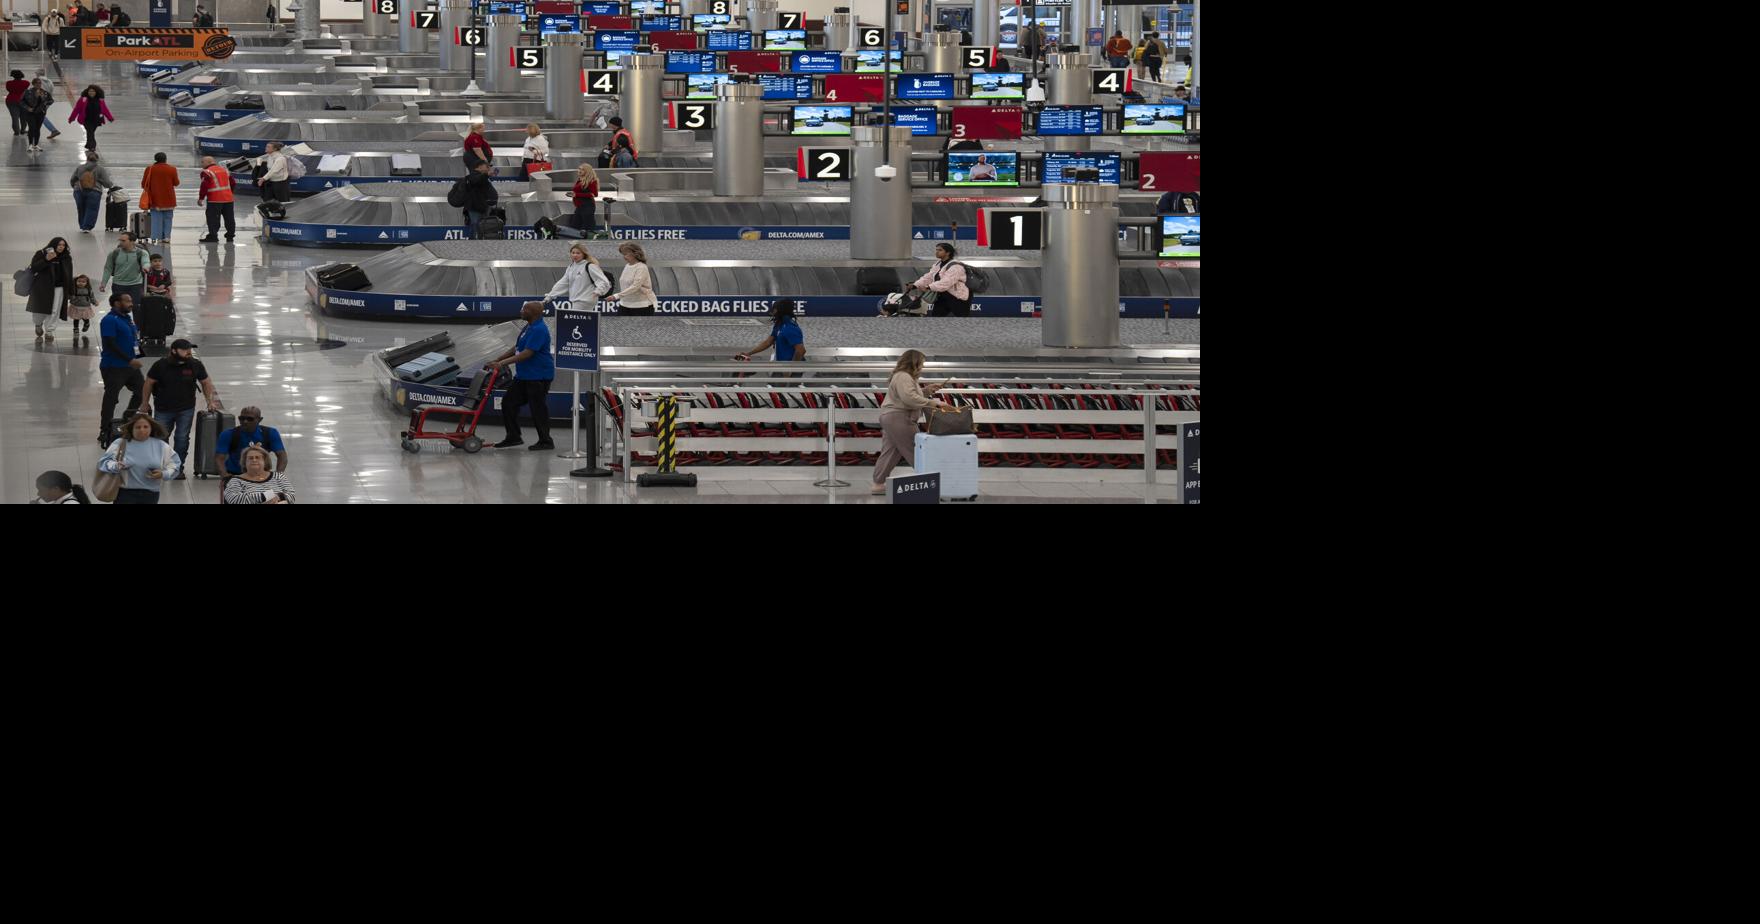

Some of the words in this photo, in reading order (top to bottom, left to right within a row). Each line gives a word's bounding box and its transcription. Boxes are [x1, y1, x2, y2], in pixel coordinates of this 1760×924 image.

[381, 1, 393, 13] 8
[713, 2, 726, 14] 8
[421, 14, 434, 27] 7
[783, 14, 797, 28] 7
[117, 36, 150, 45] Park
[151, 37, 181, 46] ATL
[465, 30, 480, 45] 6
[864, 30, 880, 45] 6
[105, 49, 159, 57] On-Airport
[162, 49, 199, 57] Parking
[651, 43, 660, 52] 6
[523, 50, 539, 66] 5
[968, 49, 985, 67] 5
[729, 65, 740, 74] 5
[593, 73, 613, 92] 4
[1098, 73, 1120, 91] 4
[826, 90, 838, 101] 4
[685, 106, 705, 127] 3
[954, 124, 966, 137] 3
[816, 152, 840, 178] 2
[1142, 173, 1156, 189] 2
[444, 229, 469, 241] ATL,
[625, 229, 656, 240] FLIES
[768, 231, 824, 239] DELTA.COM/AMEX
[1009, 215, 1023, 246] 1
[329, 297, 365, 307] DELTA.COM/AMEX
[654, 300, 698, 313] ECKED
[701, 300, 730, 313] BAG
[733, 300, 769, 313] FLIES
[409, 391, 457, 405] DELTA.COM/AMEX
[905, 482, 929, 492] DELTA
[1186, 480, 1198, 489] APP
